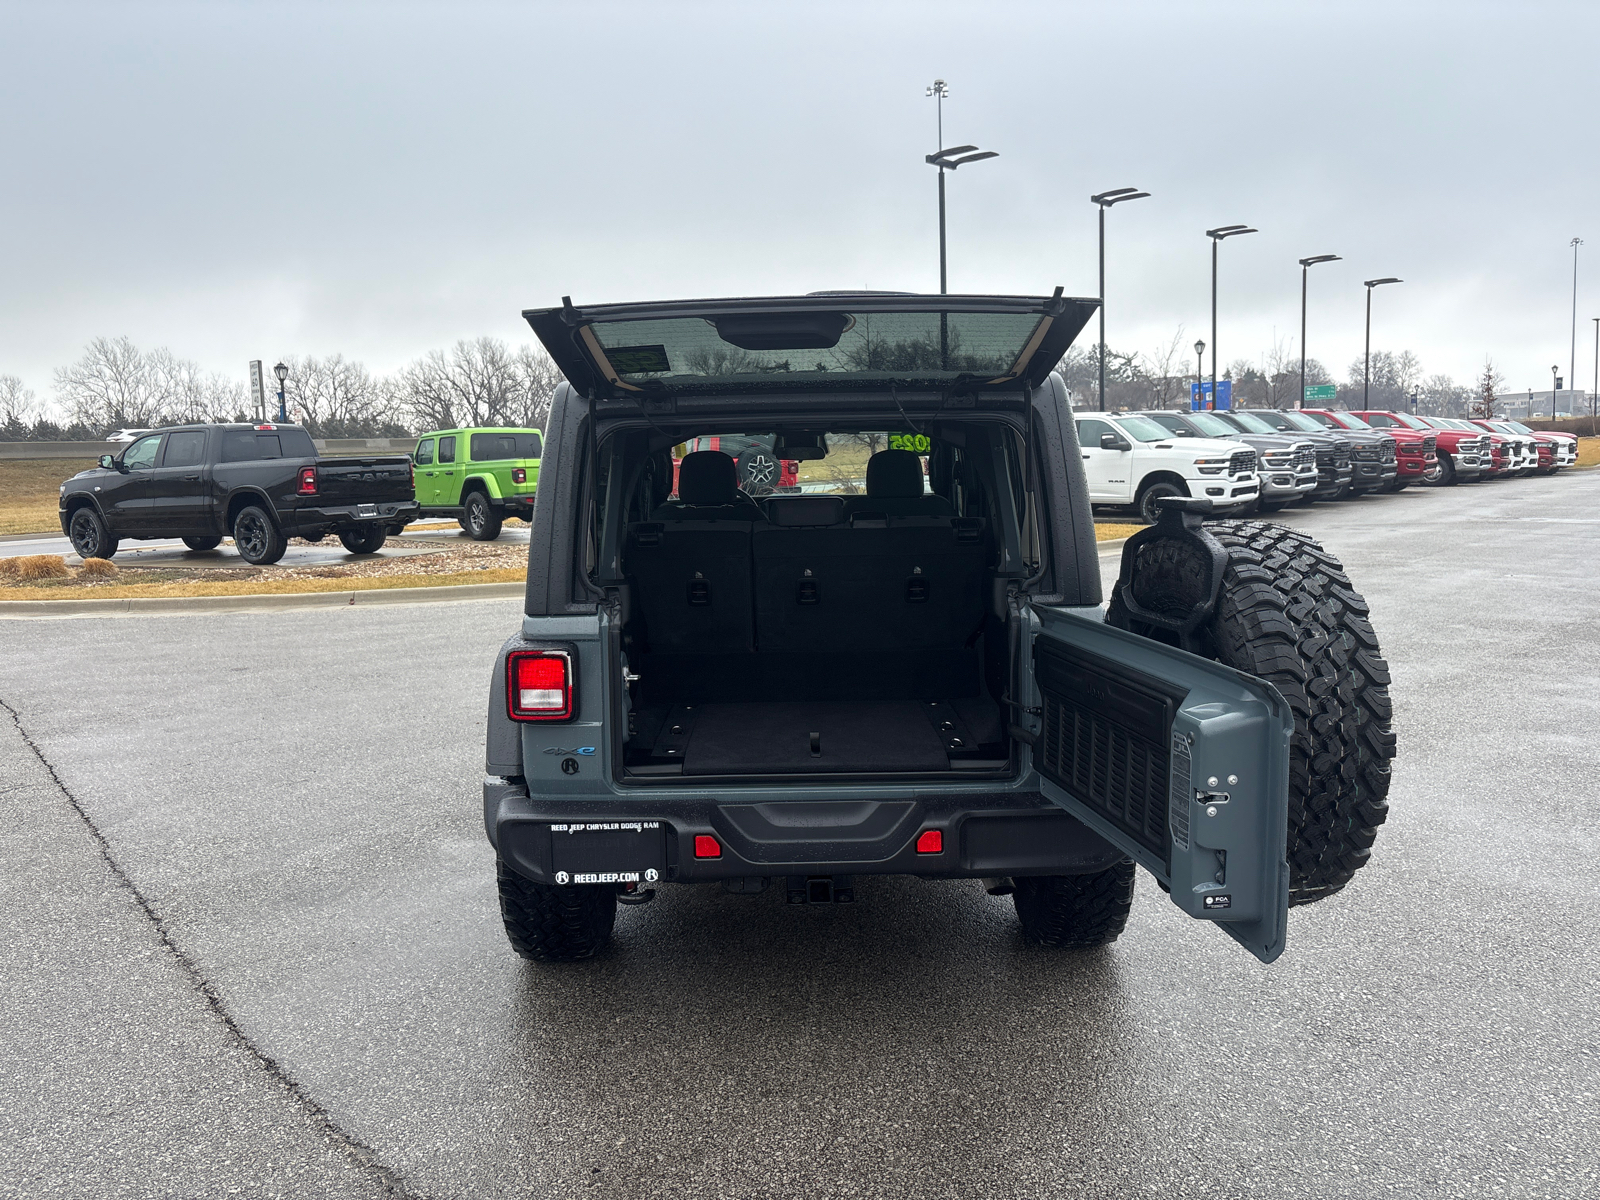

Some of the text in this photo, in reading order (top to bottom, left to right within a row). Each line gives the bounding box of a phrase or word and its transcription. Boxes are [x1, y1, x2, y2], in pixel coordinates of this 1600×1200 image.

[347, 472, 389, 481] RAM
[570, 823, 585, 831] JEEP
[620, 822, 642, 830] DODGE
[574, 873, 639, 883] REEDJEEP.COM
